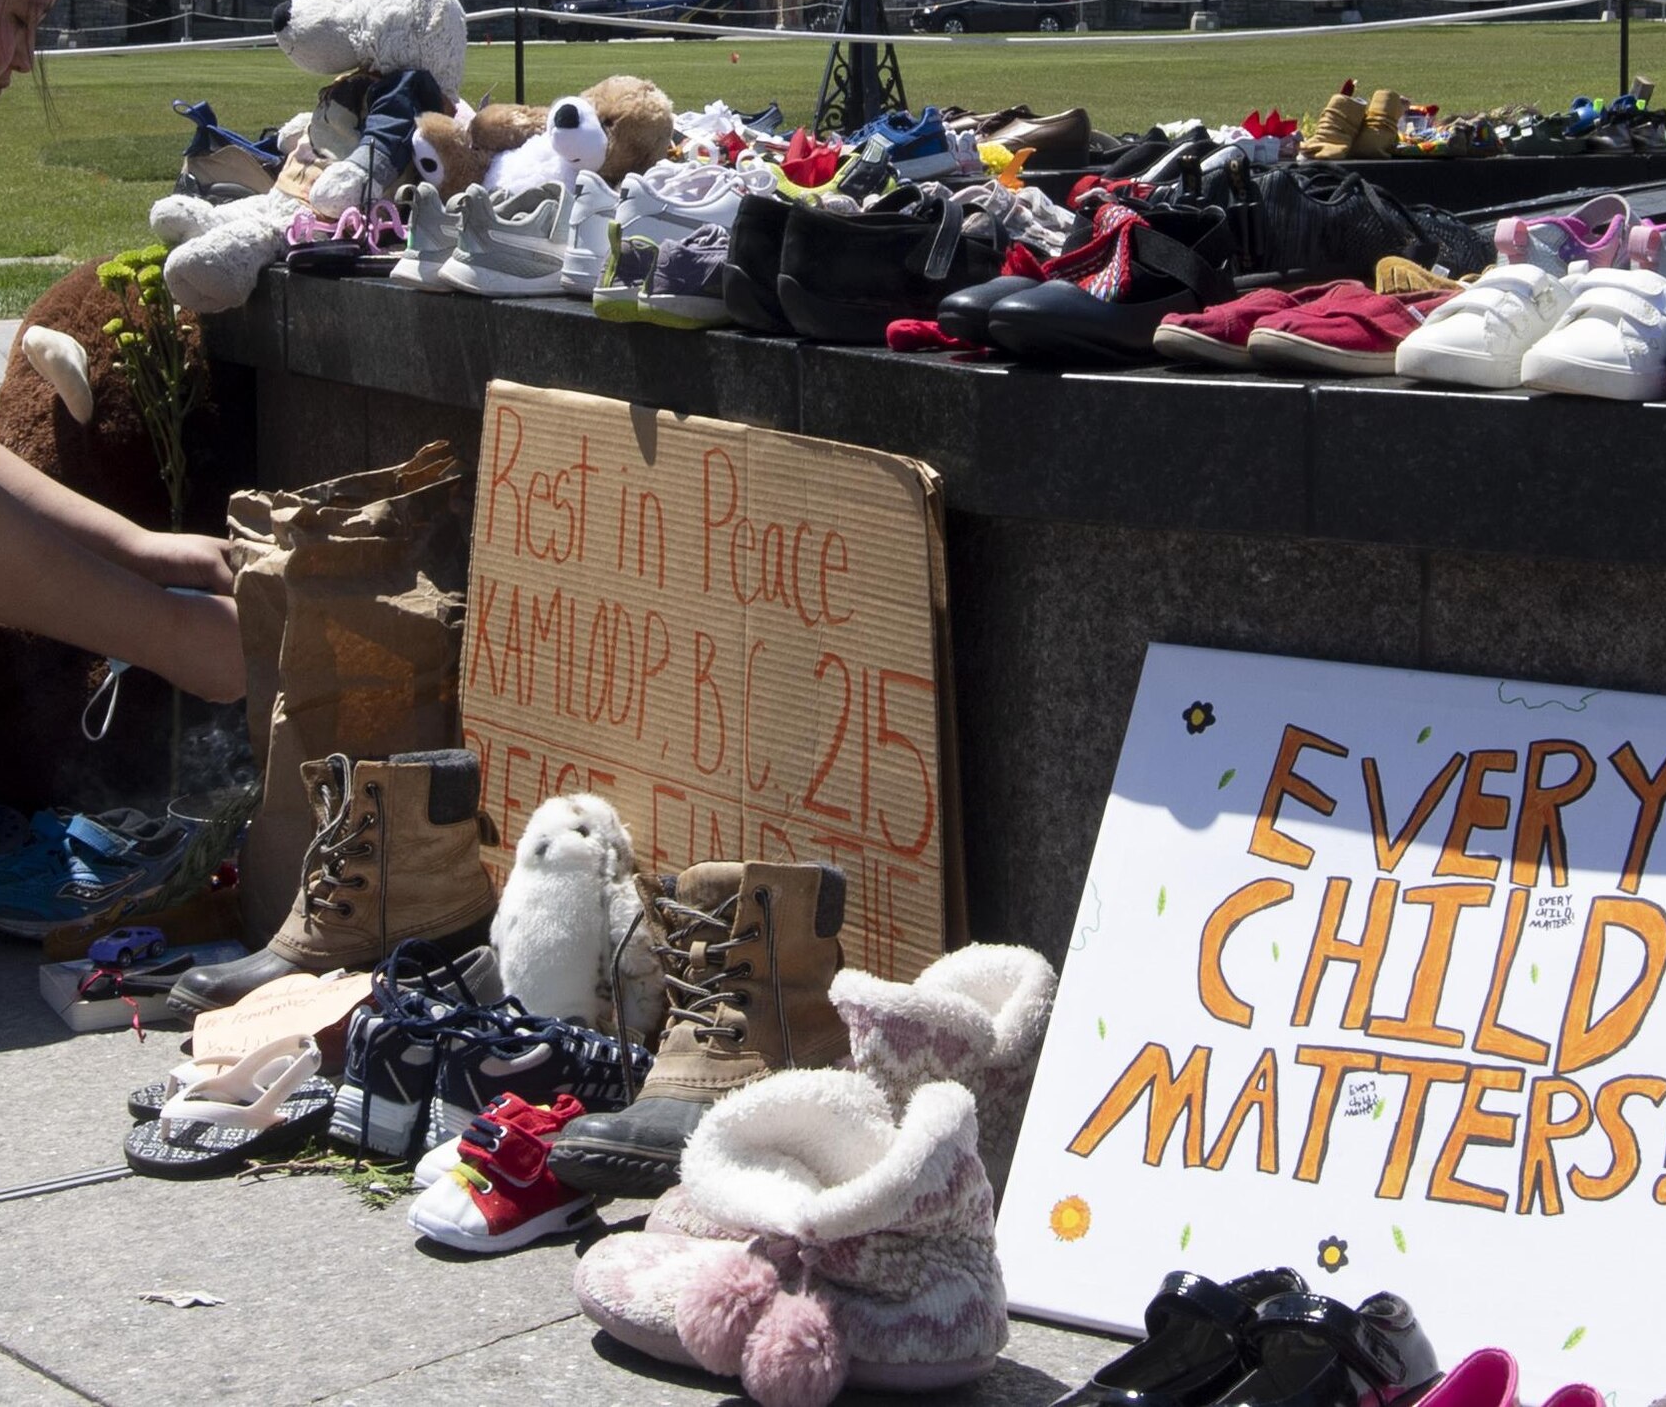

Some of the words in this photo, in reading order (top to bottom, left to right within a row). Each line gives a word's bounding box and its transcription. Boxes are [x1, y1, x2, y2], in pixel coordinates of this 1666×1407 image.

[485, 406, 599, 565] Rest
[617, 466, 665, 590] in
[702, 447, 855, 628] Peace
[801, 651, 937, 860] 215
[1538, 894, 1573, 907] EVERY
